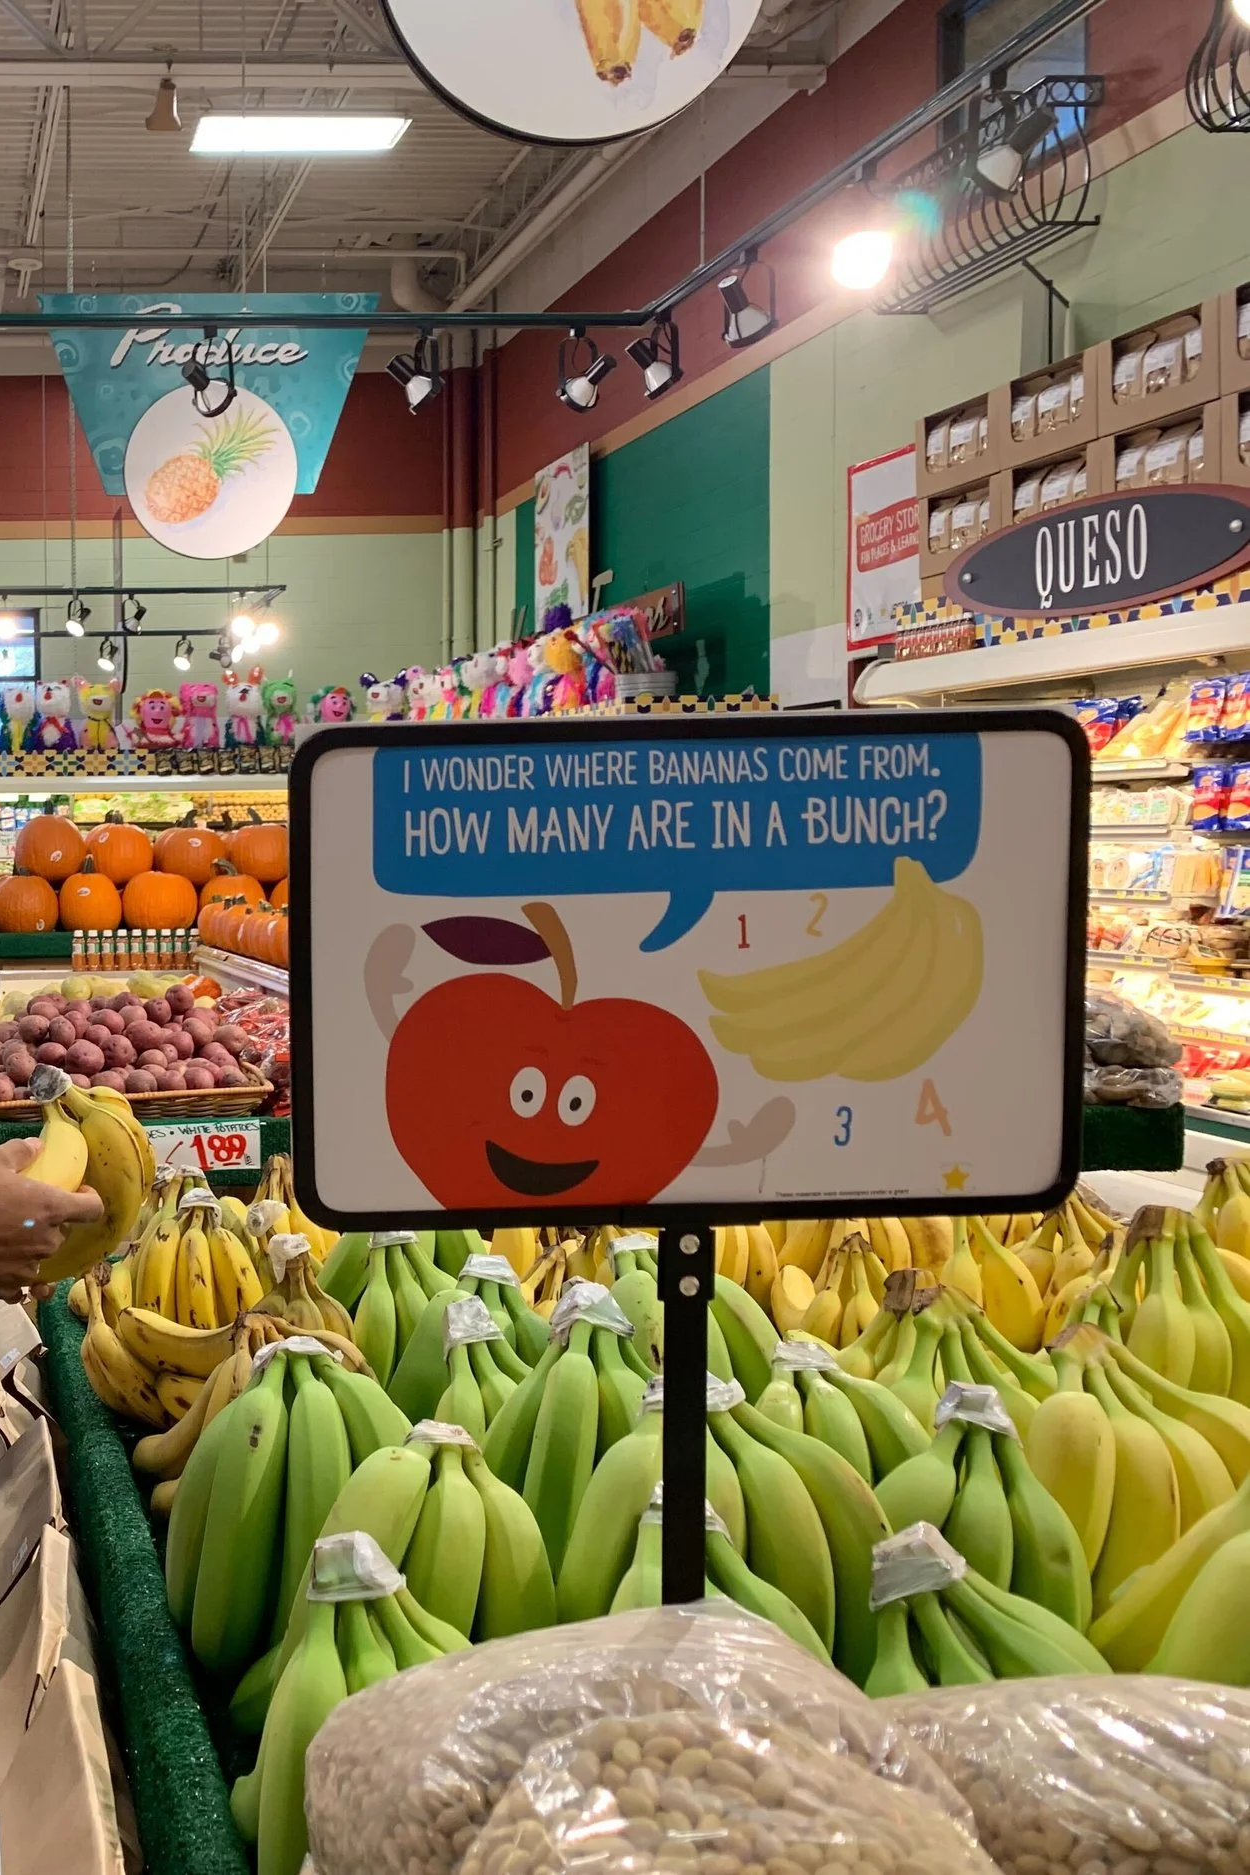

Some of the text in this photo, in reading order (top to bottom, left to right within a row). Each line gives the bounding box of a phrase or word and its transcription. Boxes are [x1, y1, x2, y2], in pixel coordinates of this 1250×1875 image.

[110, 302, 309, 368] Produce
[860, 514, 895, 547] GROCERY
[860, 549, 871, 565] FUN
[871, 543, 890, 560] PLACES
[1035, 503, 1148, 610] QUESO
[404, 743, 941, 793] I WONDER WHERE BANANAS COME FROM.
[405, 788, 948, 857] HOW MANY ARE IN A BUNCH?
[737, 892, 828, 949] 1 2
[178, 1126, 211, 1135] WHITE
[214, 1122, 260, 1133] POTATOES
[833, 1078, 952, 1146] 3 4
[190, 1134, 247, 1171] 1.89
